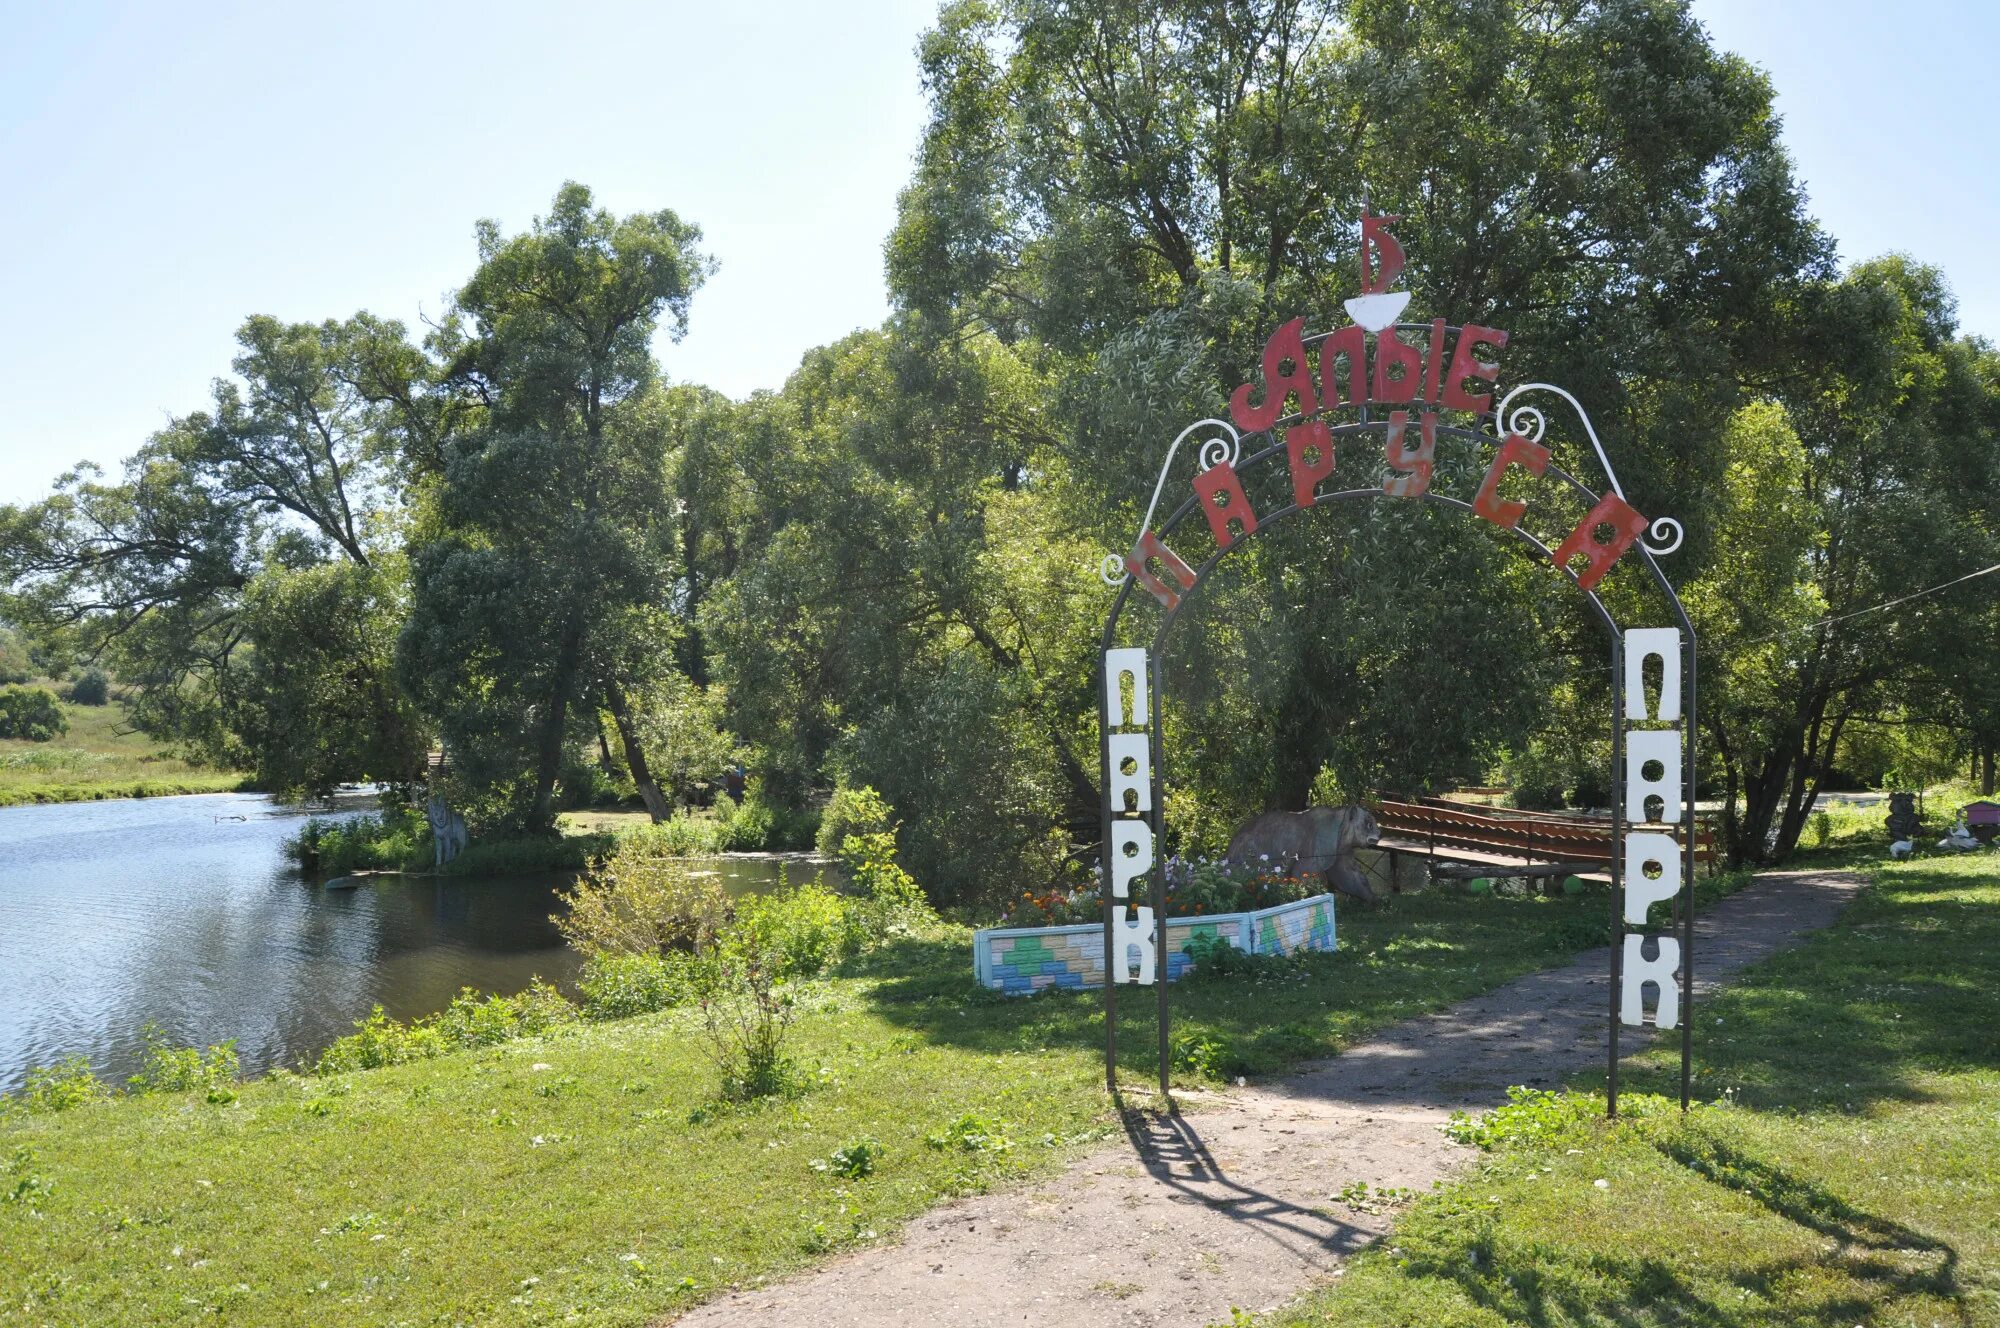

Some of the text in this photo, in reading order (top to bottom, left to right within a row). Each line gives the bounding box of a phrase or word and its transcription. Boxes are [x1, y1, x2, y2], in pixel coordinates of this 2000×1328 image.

[1125, 411, 1649, 610] ПАРУСА
[1106, 648, 1155, 985] ПАРК
[1621, 628, 1682, 1030] ПАРК
